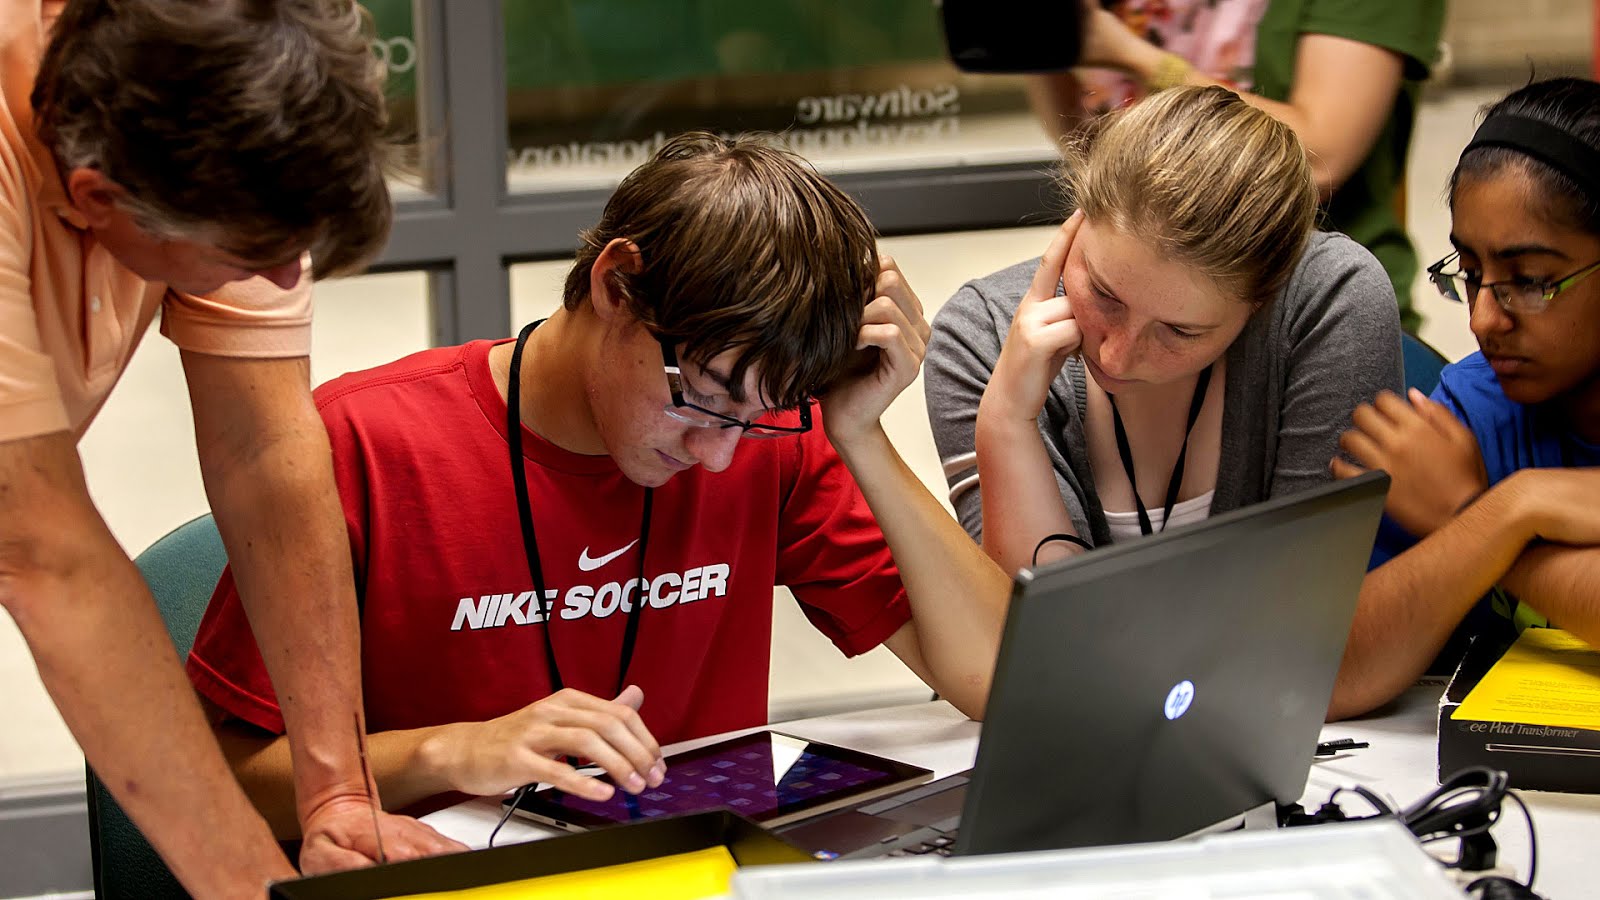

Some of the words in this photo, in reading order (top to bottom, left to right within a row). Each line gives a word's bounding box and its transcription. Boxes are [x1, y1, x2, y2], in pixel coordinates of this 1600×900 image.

[450, 589, 558, 630] NIKE
[560, 563, 730, 620] SOCCER
[1489, 721, 1517, 735] Pad
[1517, 724, 1579, 738] Transformer
